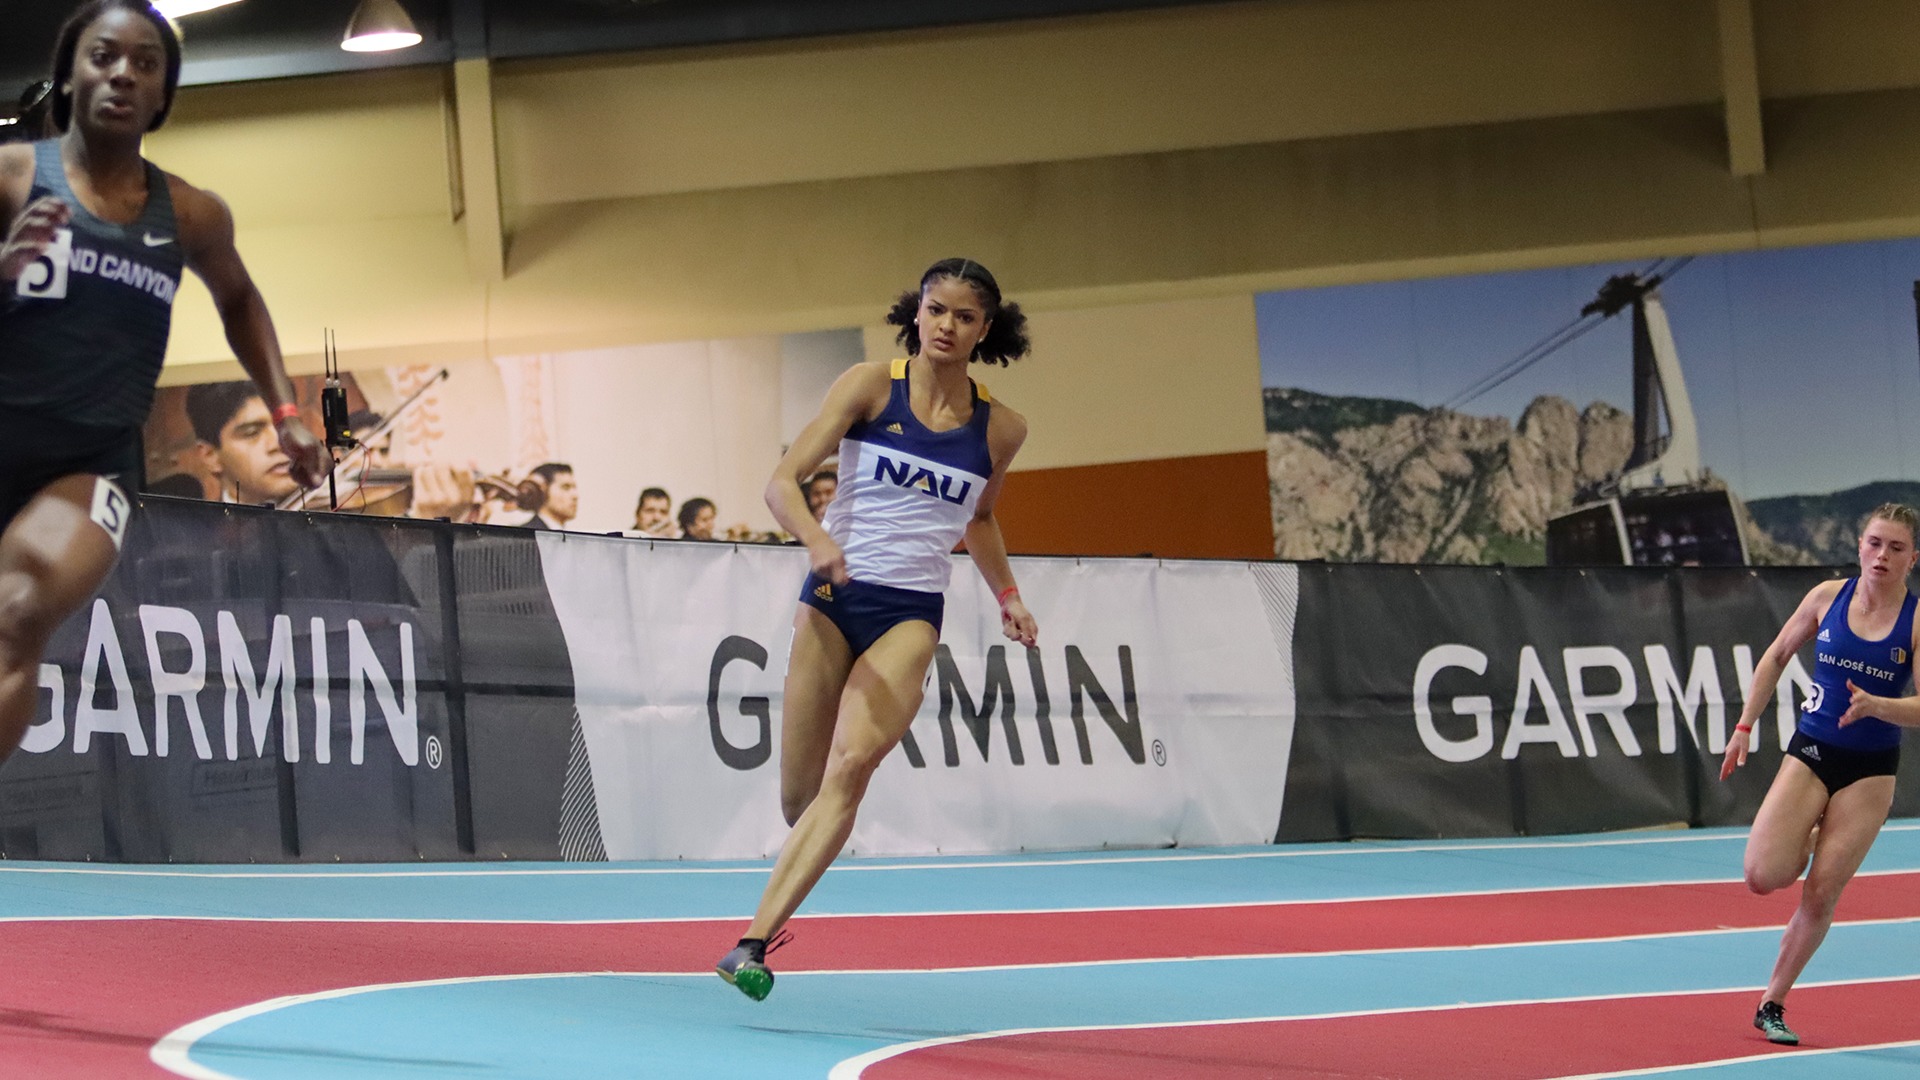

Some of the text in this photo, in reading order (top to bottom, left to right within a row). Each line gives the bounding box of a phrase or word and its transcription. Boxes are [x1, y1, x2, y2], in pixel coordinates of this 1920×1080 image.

[874, 455, 971, 505] NAU
[102, 488, 124, 534] 5
[1819, 652, 1895, 681] SAN JOSÉ STATE
[707, 635, 1146, 770] GMIN
[1803, 683, 1820, 711] 3
